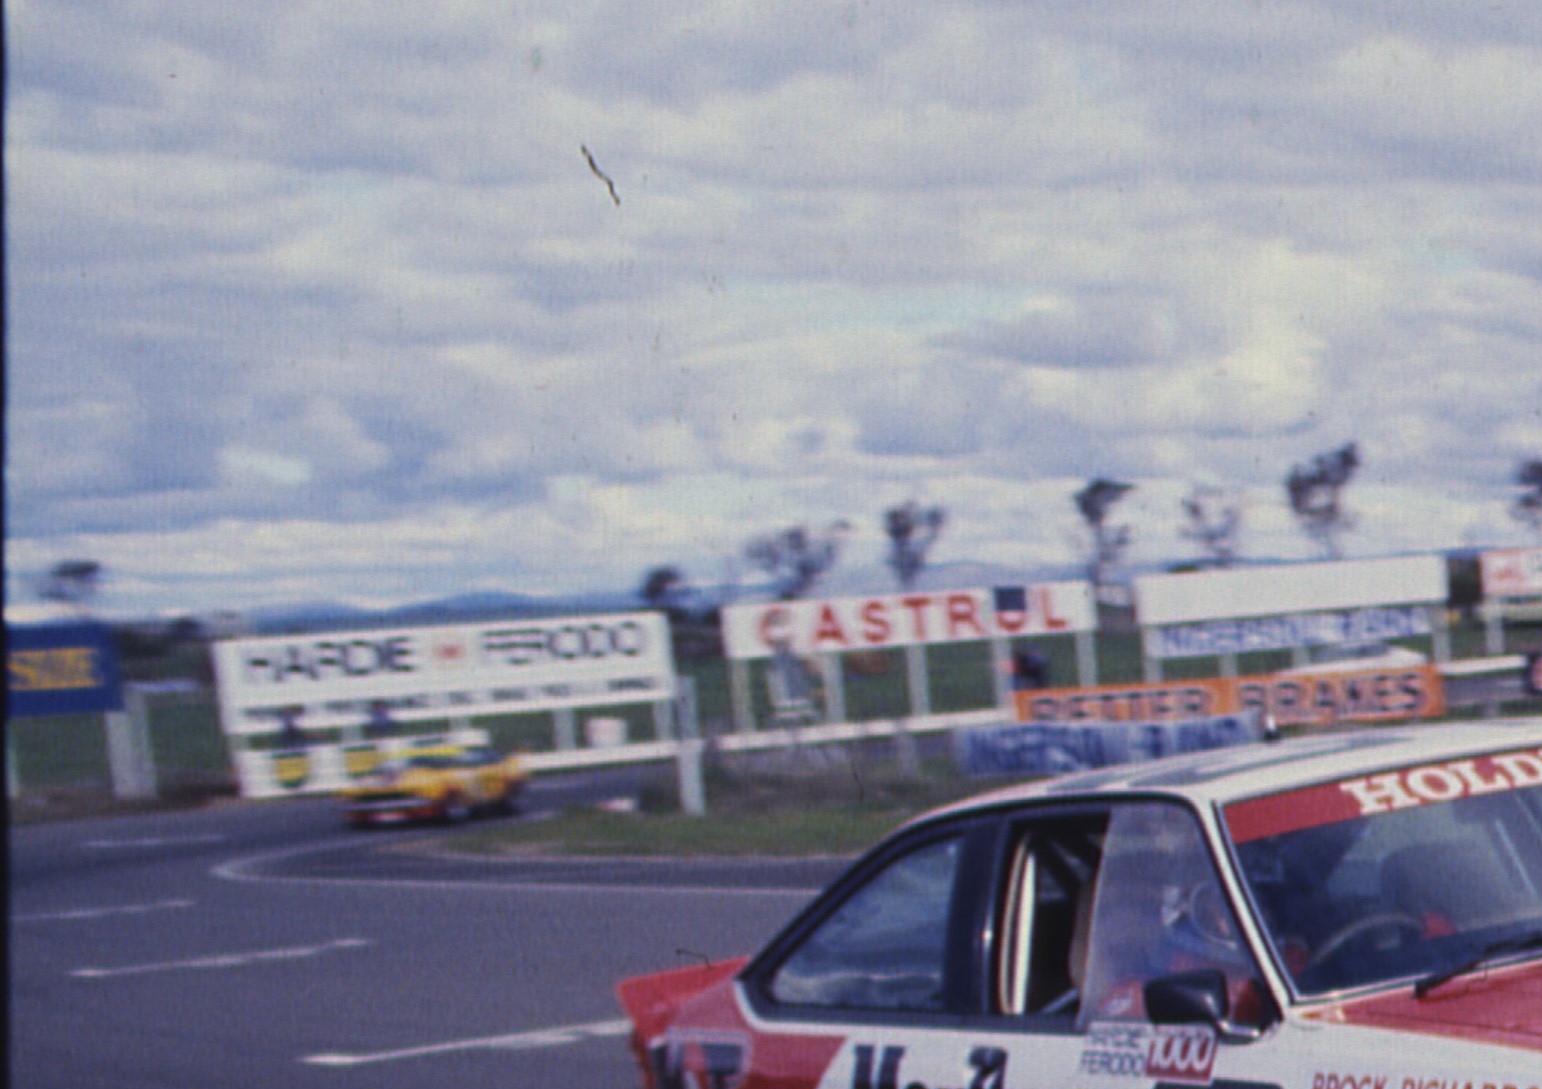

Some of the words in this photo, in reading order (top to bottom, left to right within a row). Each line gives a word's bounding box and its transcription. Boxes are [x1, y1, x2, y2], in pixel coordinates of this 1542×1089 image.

[757, 588, 1068, 651] CASTROL
[246, 634, 415, 683] HARDIE
[484, 620, 642, 668] FERODO
[1149, 1026, 1215, 1071] 1000
